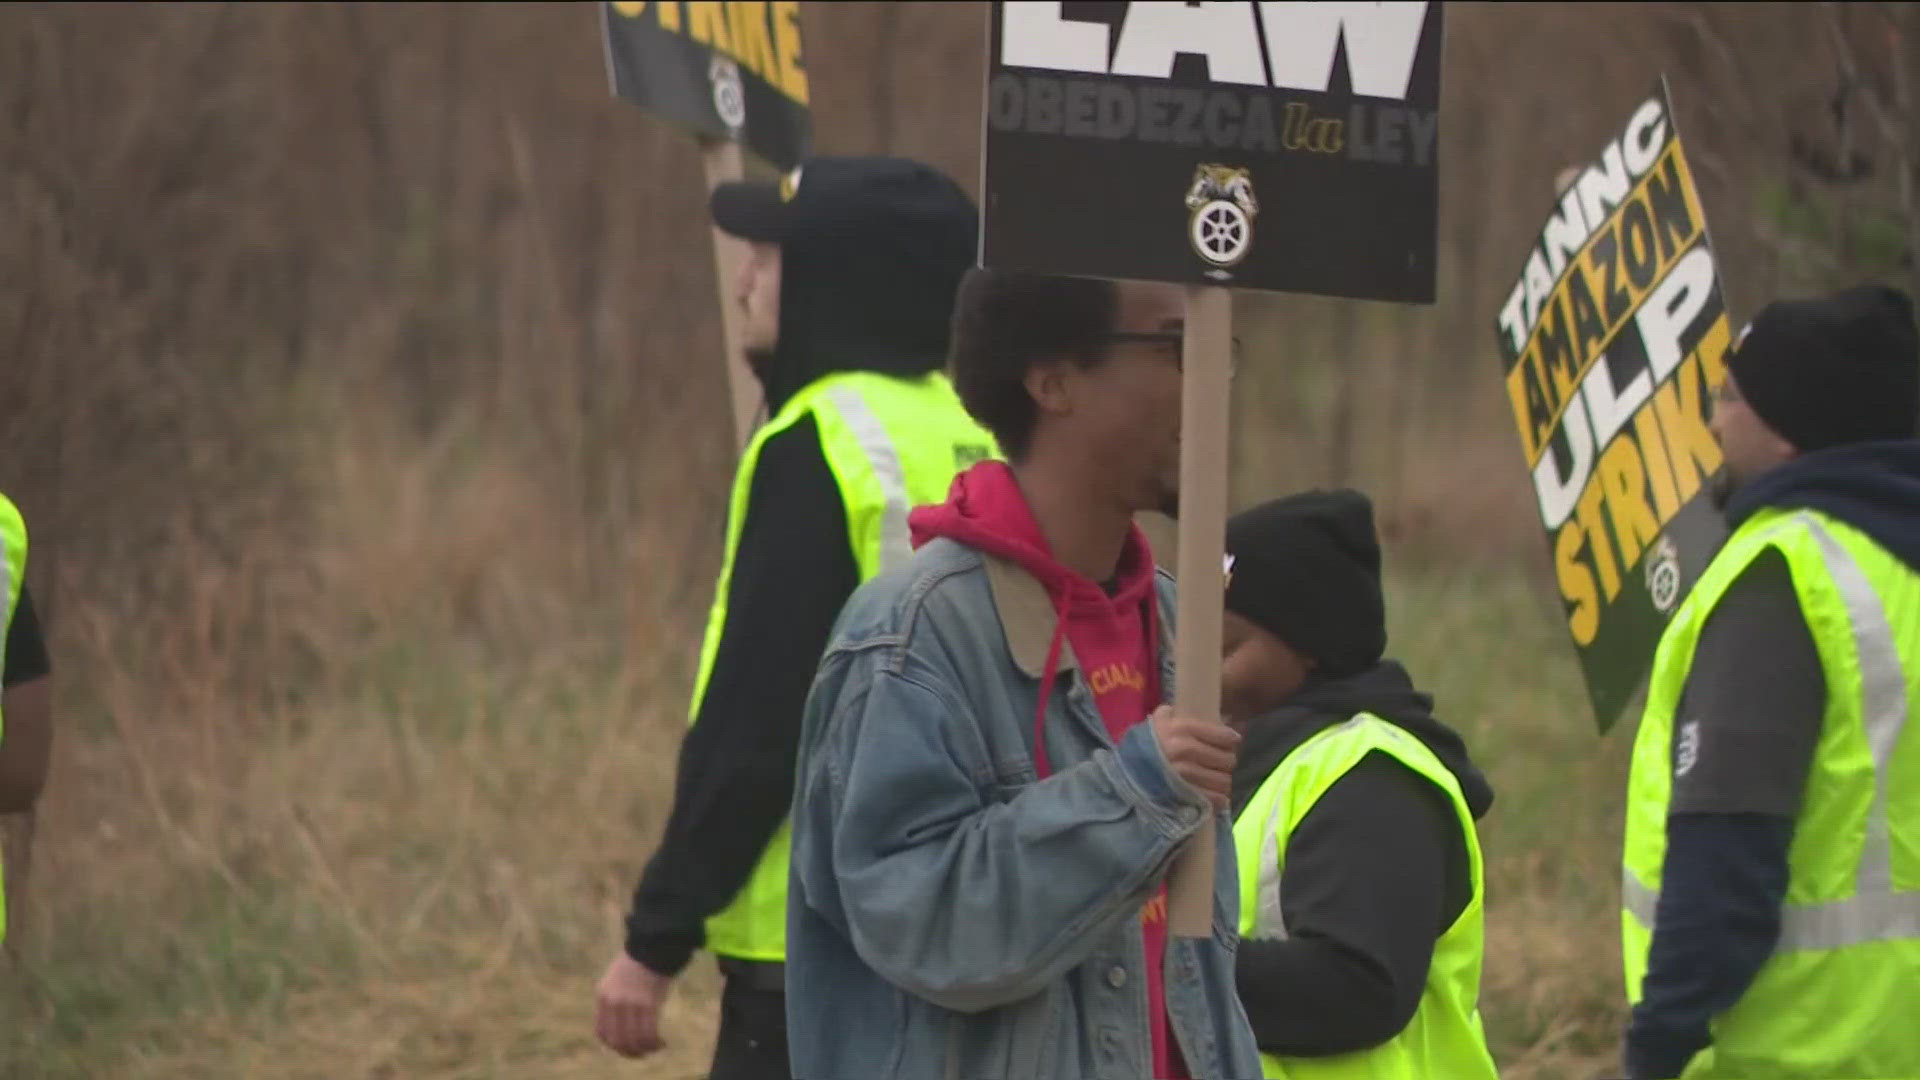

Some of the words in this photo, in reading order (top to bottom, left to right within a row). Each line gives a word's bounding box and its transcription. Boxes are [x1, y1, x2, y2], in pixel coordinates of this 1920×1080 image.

[989, 73, 1275, 153] OBEDEZCA
[1281, 102, 1343, 153] la
[1347, 104, 1438, 166] LEY
[1001, 2, 1428, 100] LAW
[1500, 98, 1667, 354] TANNC
[1524, 150, 1694, 445] AMAZON
[1533, 247, 1715, 530] ULP
